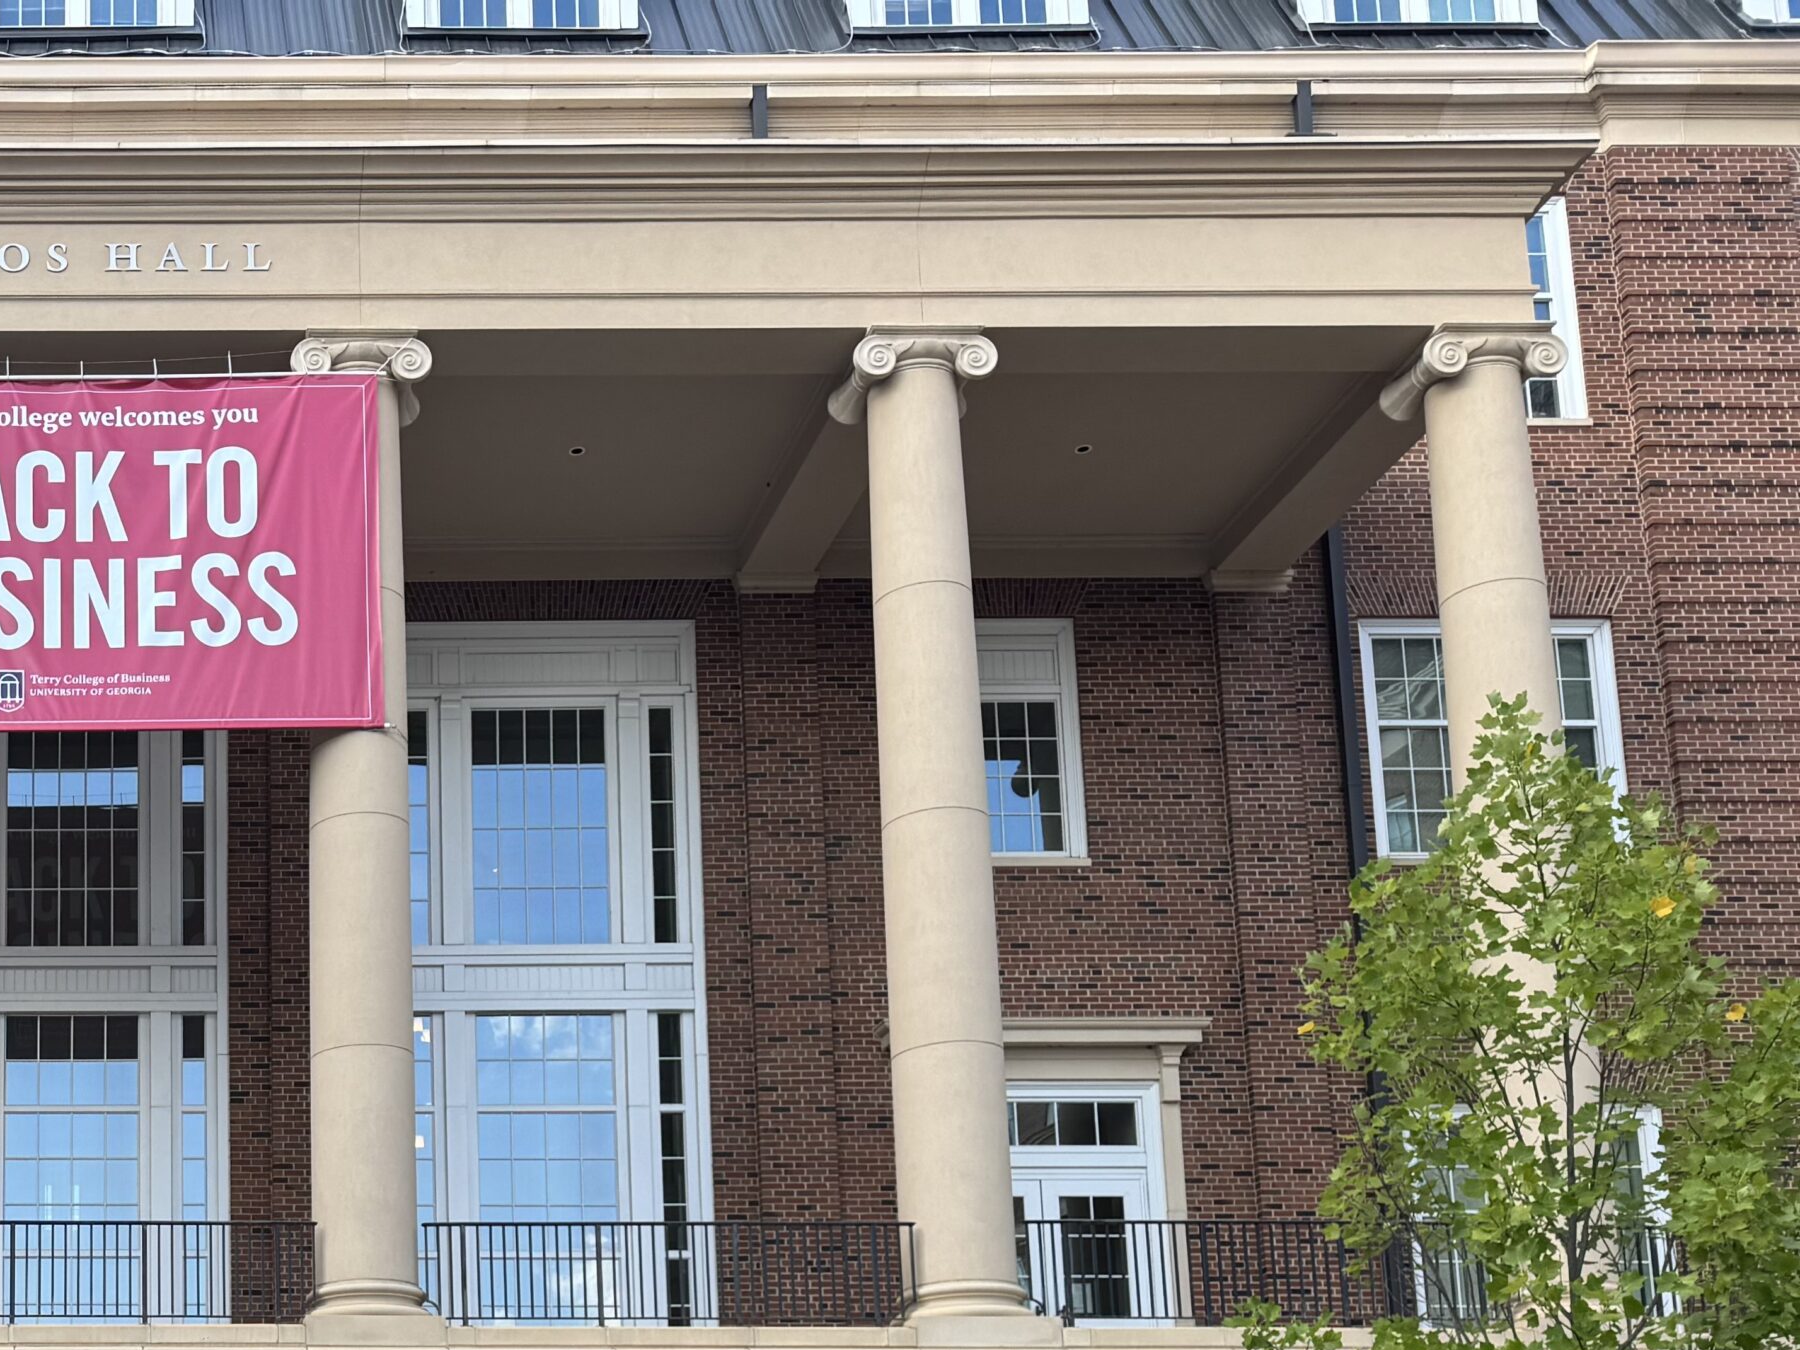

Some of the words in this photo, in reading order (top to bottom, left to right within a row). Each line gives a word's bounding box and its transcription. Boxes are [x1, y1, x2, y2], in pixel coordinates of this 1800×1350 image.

[104, 241, 272, 272] HALL
[79, 406, 205, 428] welcomes
[211, 407, 259, 432] you
[153, 446, 258, 540] TO
[30, 674, 61, 686] Terry
[63, 674, 104, 686] College
[106, 673, 120, 684] of
[121, 672, 171, 683] Business
[30, 688, 88, 696] UNIVERSITY
[90, 688, 104, 696] OF
[106, 687, 152, 696] GEORGIA
